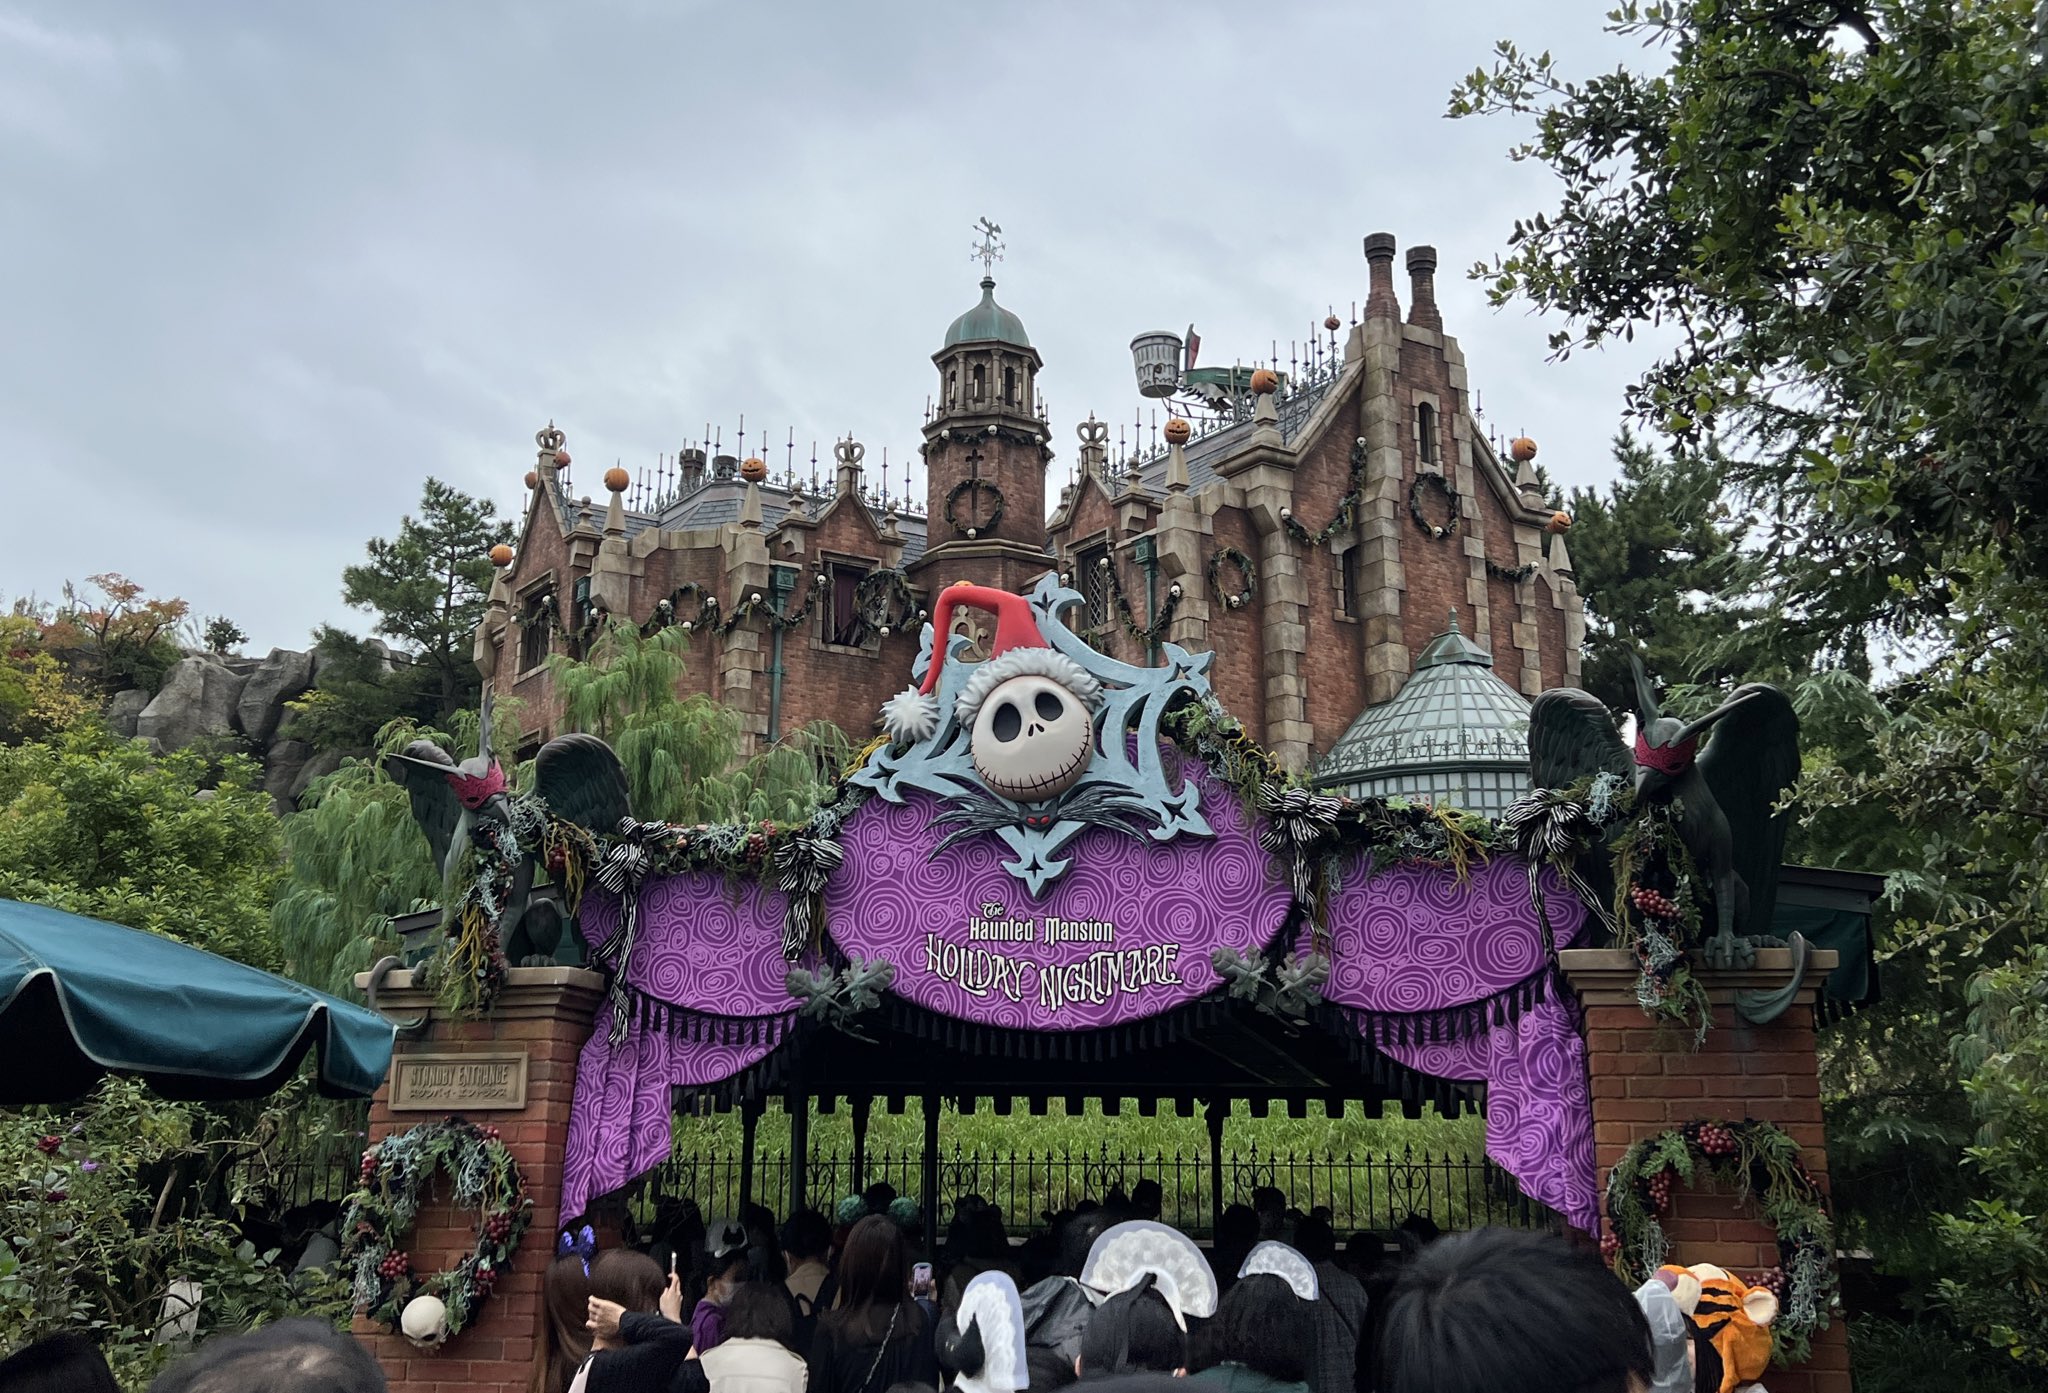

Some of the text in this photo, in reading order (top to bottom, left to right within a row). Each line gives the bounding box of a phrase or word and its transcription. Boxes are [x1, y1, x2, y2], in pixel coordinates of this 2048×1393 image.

[981, 902, 1004, 918] The
[969, 917, 1114, 945] Haunted Mansion
[925, 933, 1182, 1011] HOLIDAY NIGHTMARE
[411, 1064, 508, 1087] STANDBY ENTRANCE
